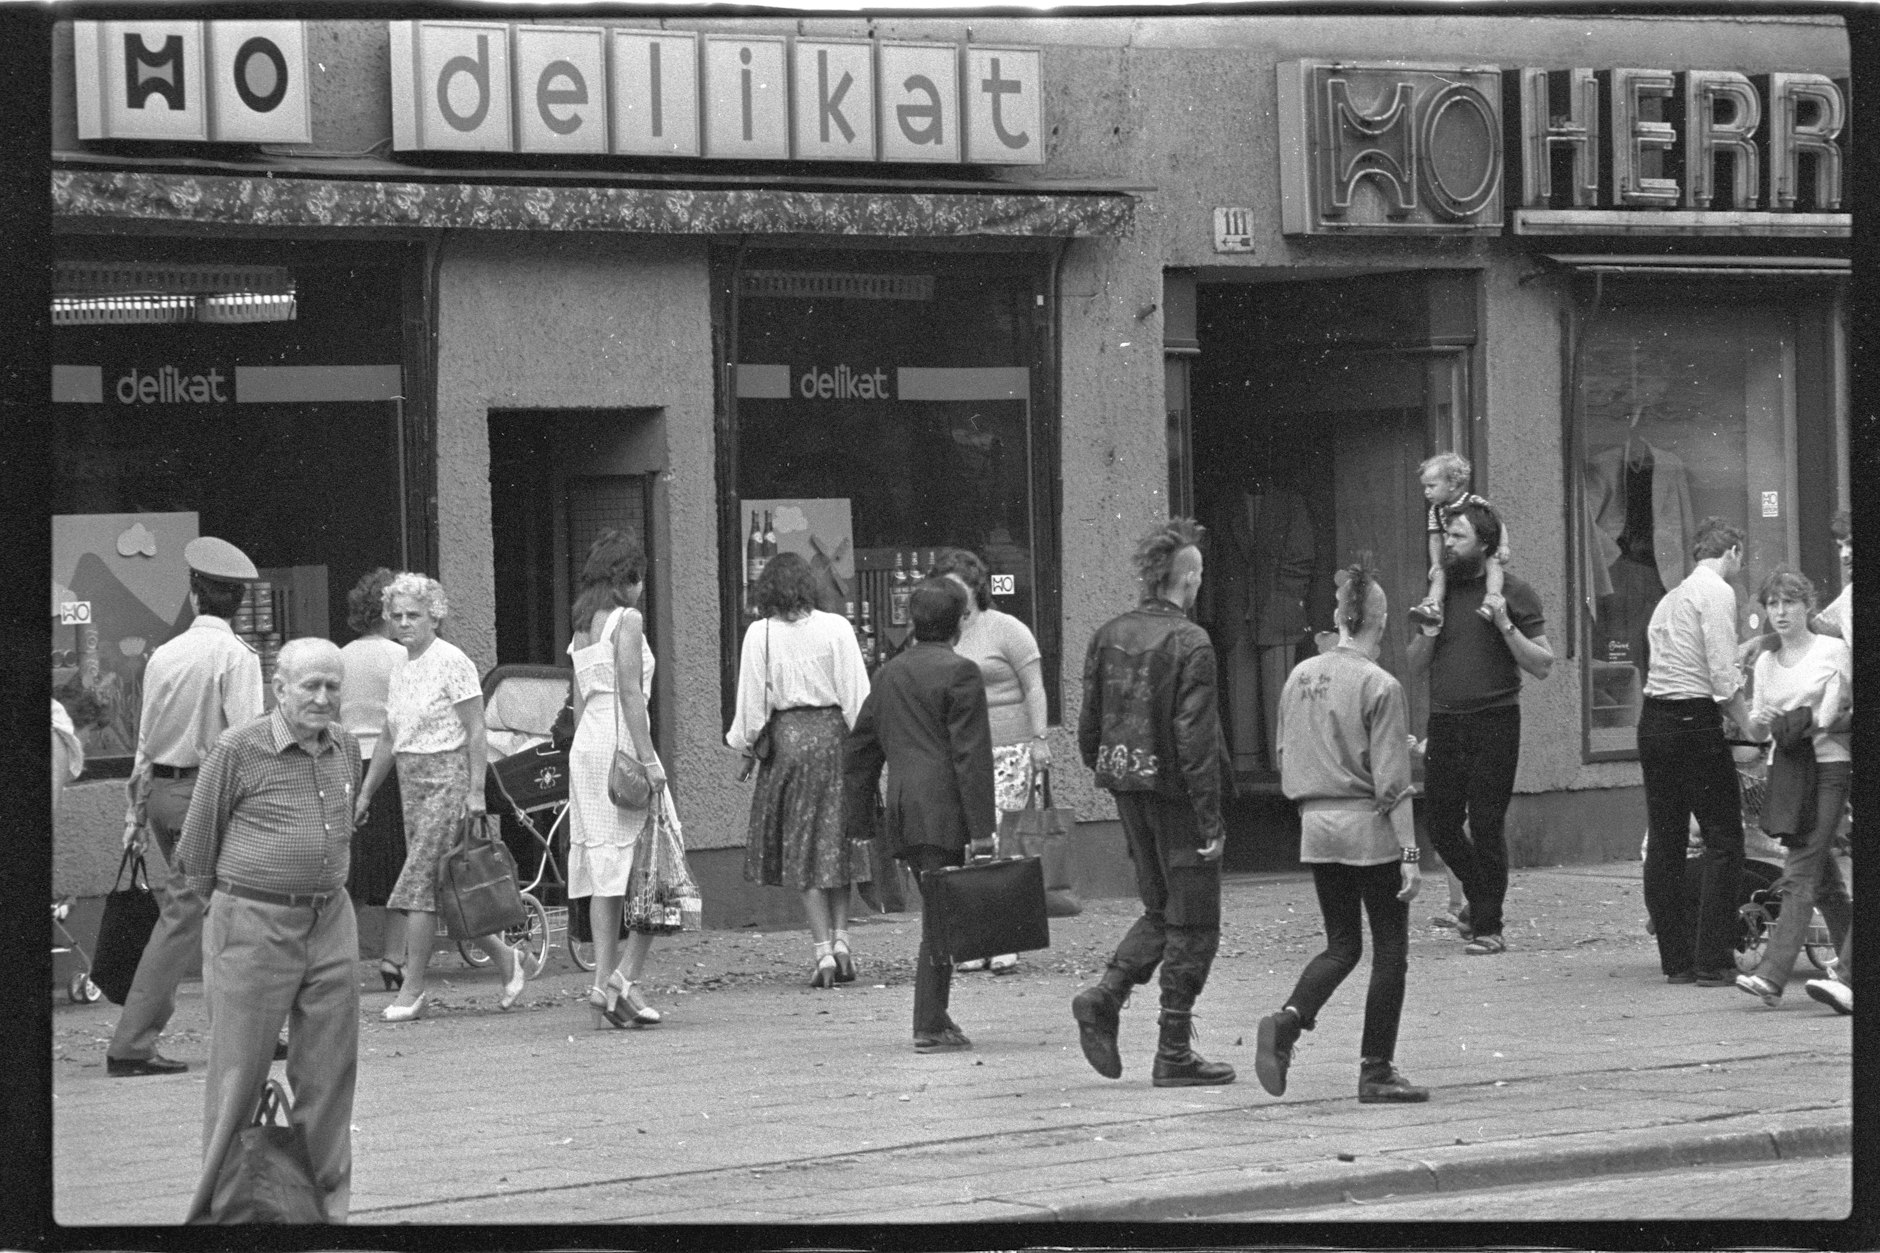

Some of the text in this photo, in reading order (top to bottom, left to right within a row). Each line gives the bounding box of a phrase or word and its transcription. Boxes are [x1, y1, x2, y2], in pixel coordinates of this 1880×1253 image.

[437, 34, 1030, 149] delikat
[117, 365, 228, 403] delikat
[801, 364, 889, 399] delikat
